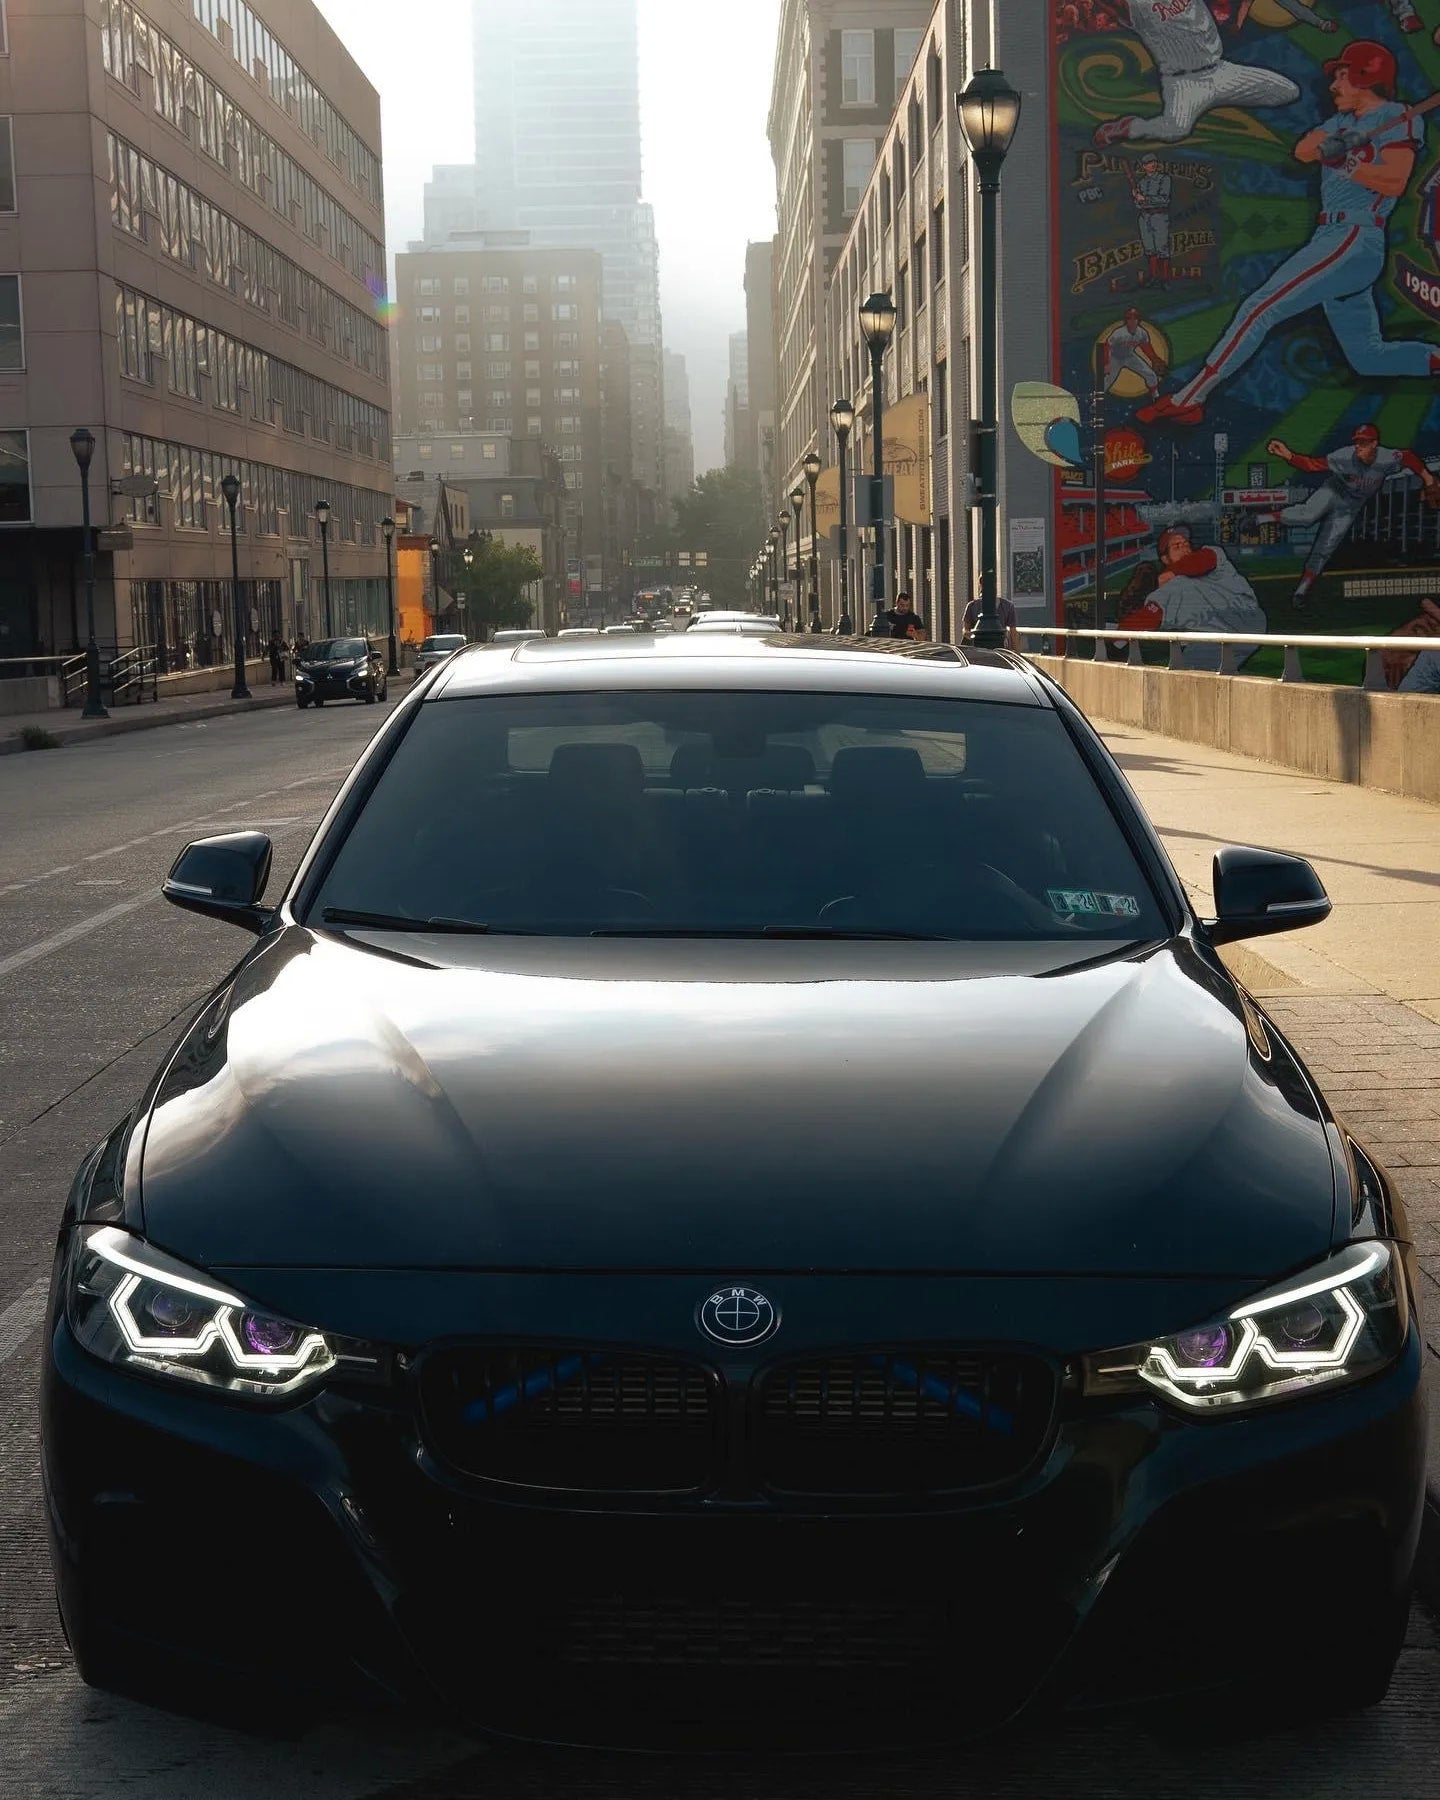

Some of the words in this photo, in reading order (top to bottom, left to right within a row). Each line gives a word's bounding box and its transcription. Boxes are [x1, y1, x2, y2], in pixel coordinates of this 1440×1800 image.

[1078, 187, 1103, 203] PBC
[1070, 240, 1144, 294] BASE
[1405, 271, 1440, 308] 1980
[1104, 441, 1144, 464] Shibe
[1111, 459, 1136, 469] PARK
[710, 1290, 767, 1306] BMW
